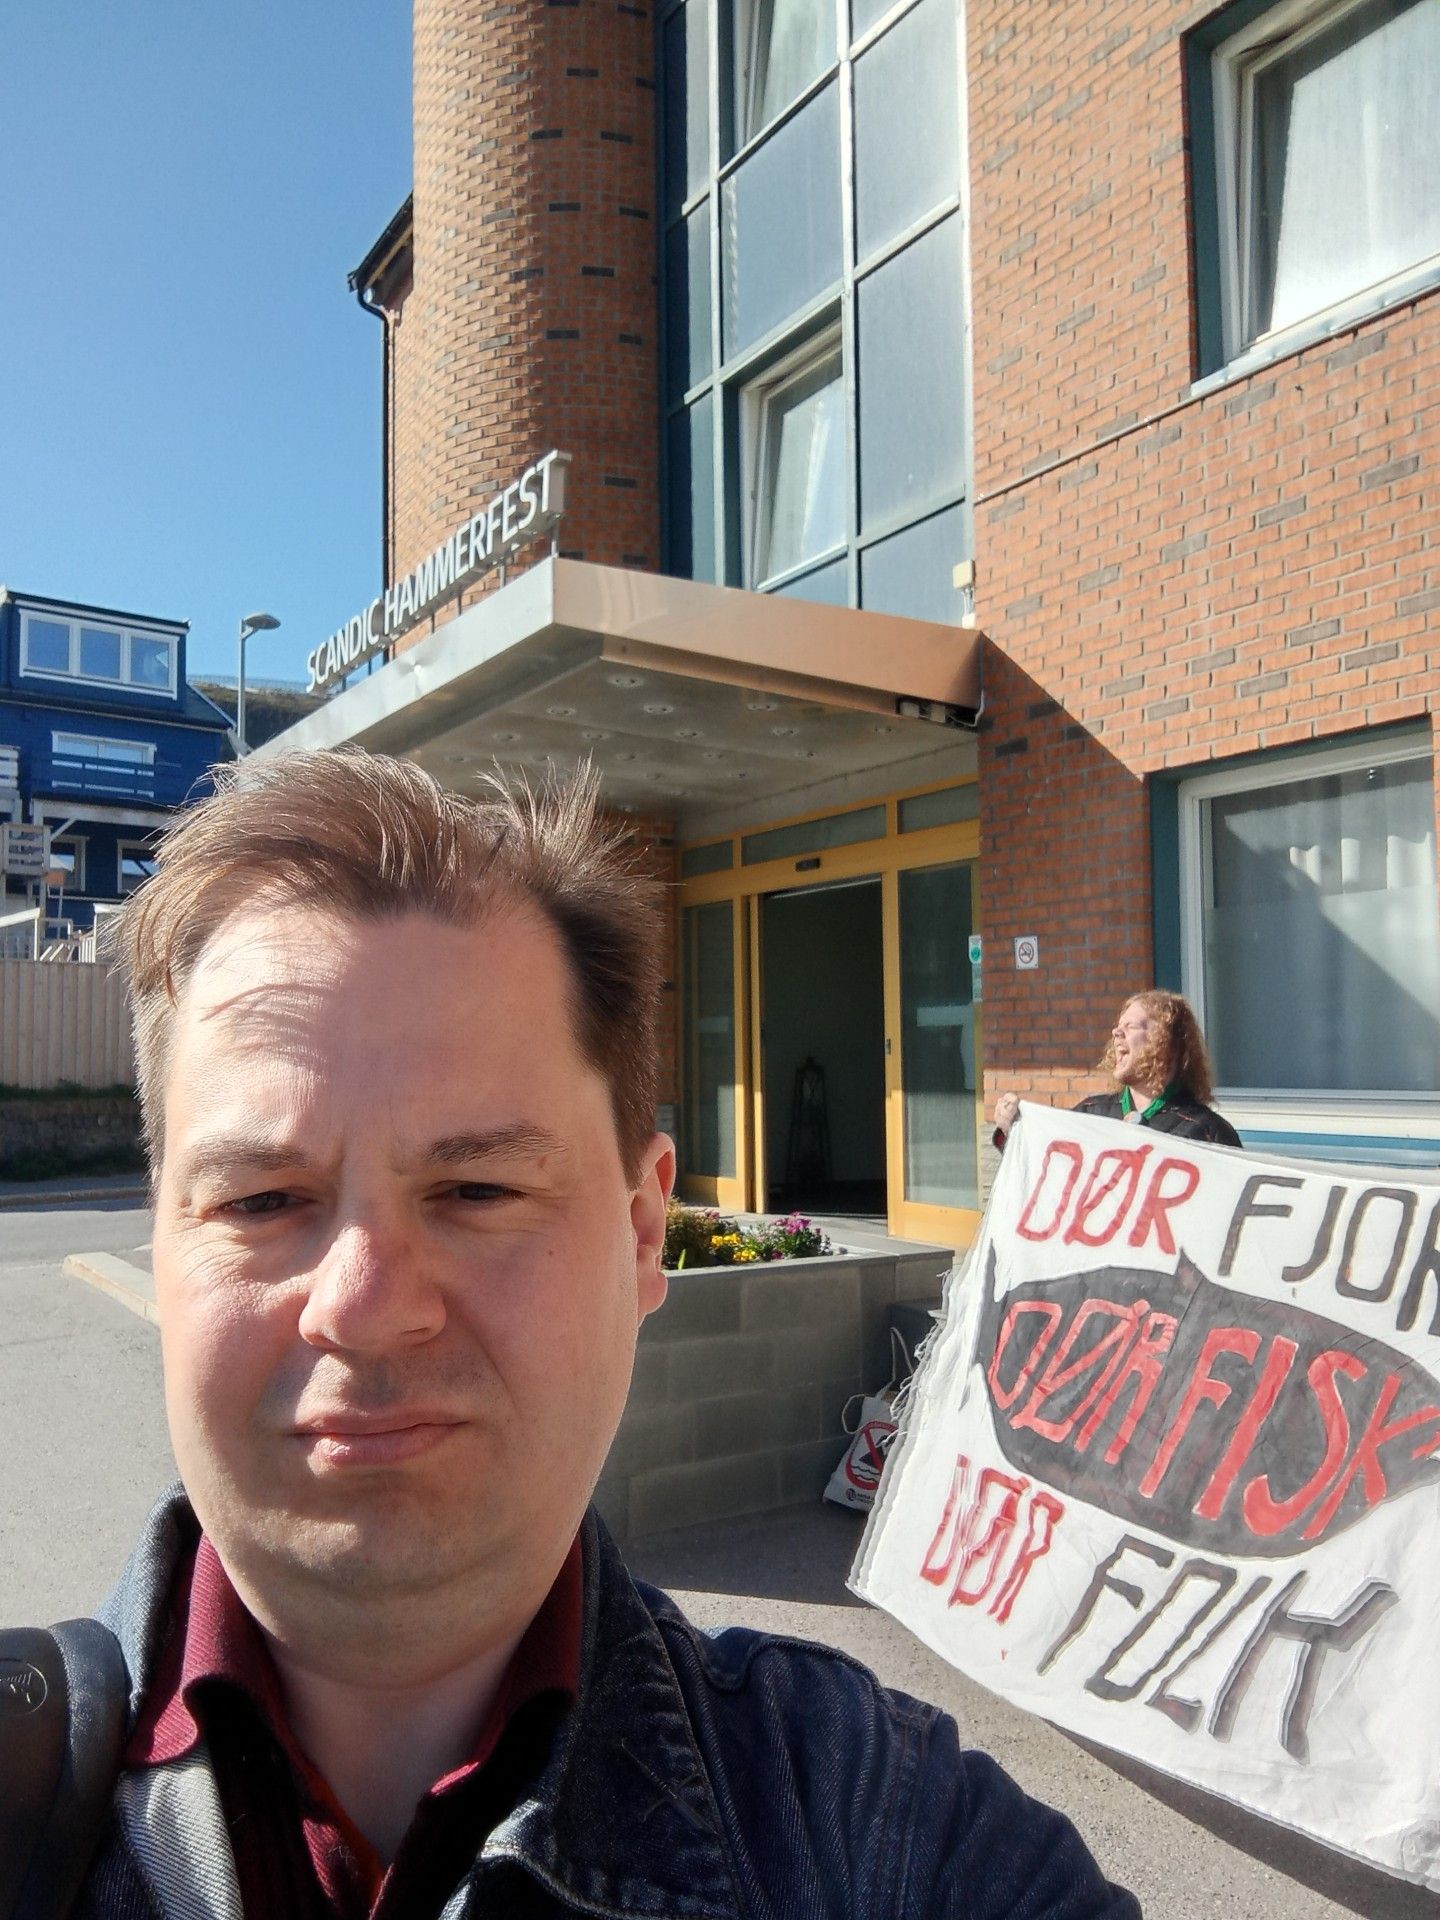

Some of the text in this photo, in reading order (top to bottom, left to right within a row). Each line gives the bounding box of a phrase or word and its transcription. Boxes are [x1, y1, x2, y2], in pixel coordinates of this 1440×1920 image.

[306, 450, 559, 692] SCANDIC HAMMERFEST
[1016, 1140, 1200, 1254] DØR
[988, 1298, 1440, 1540] DØR FISK
